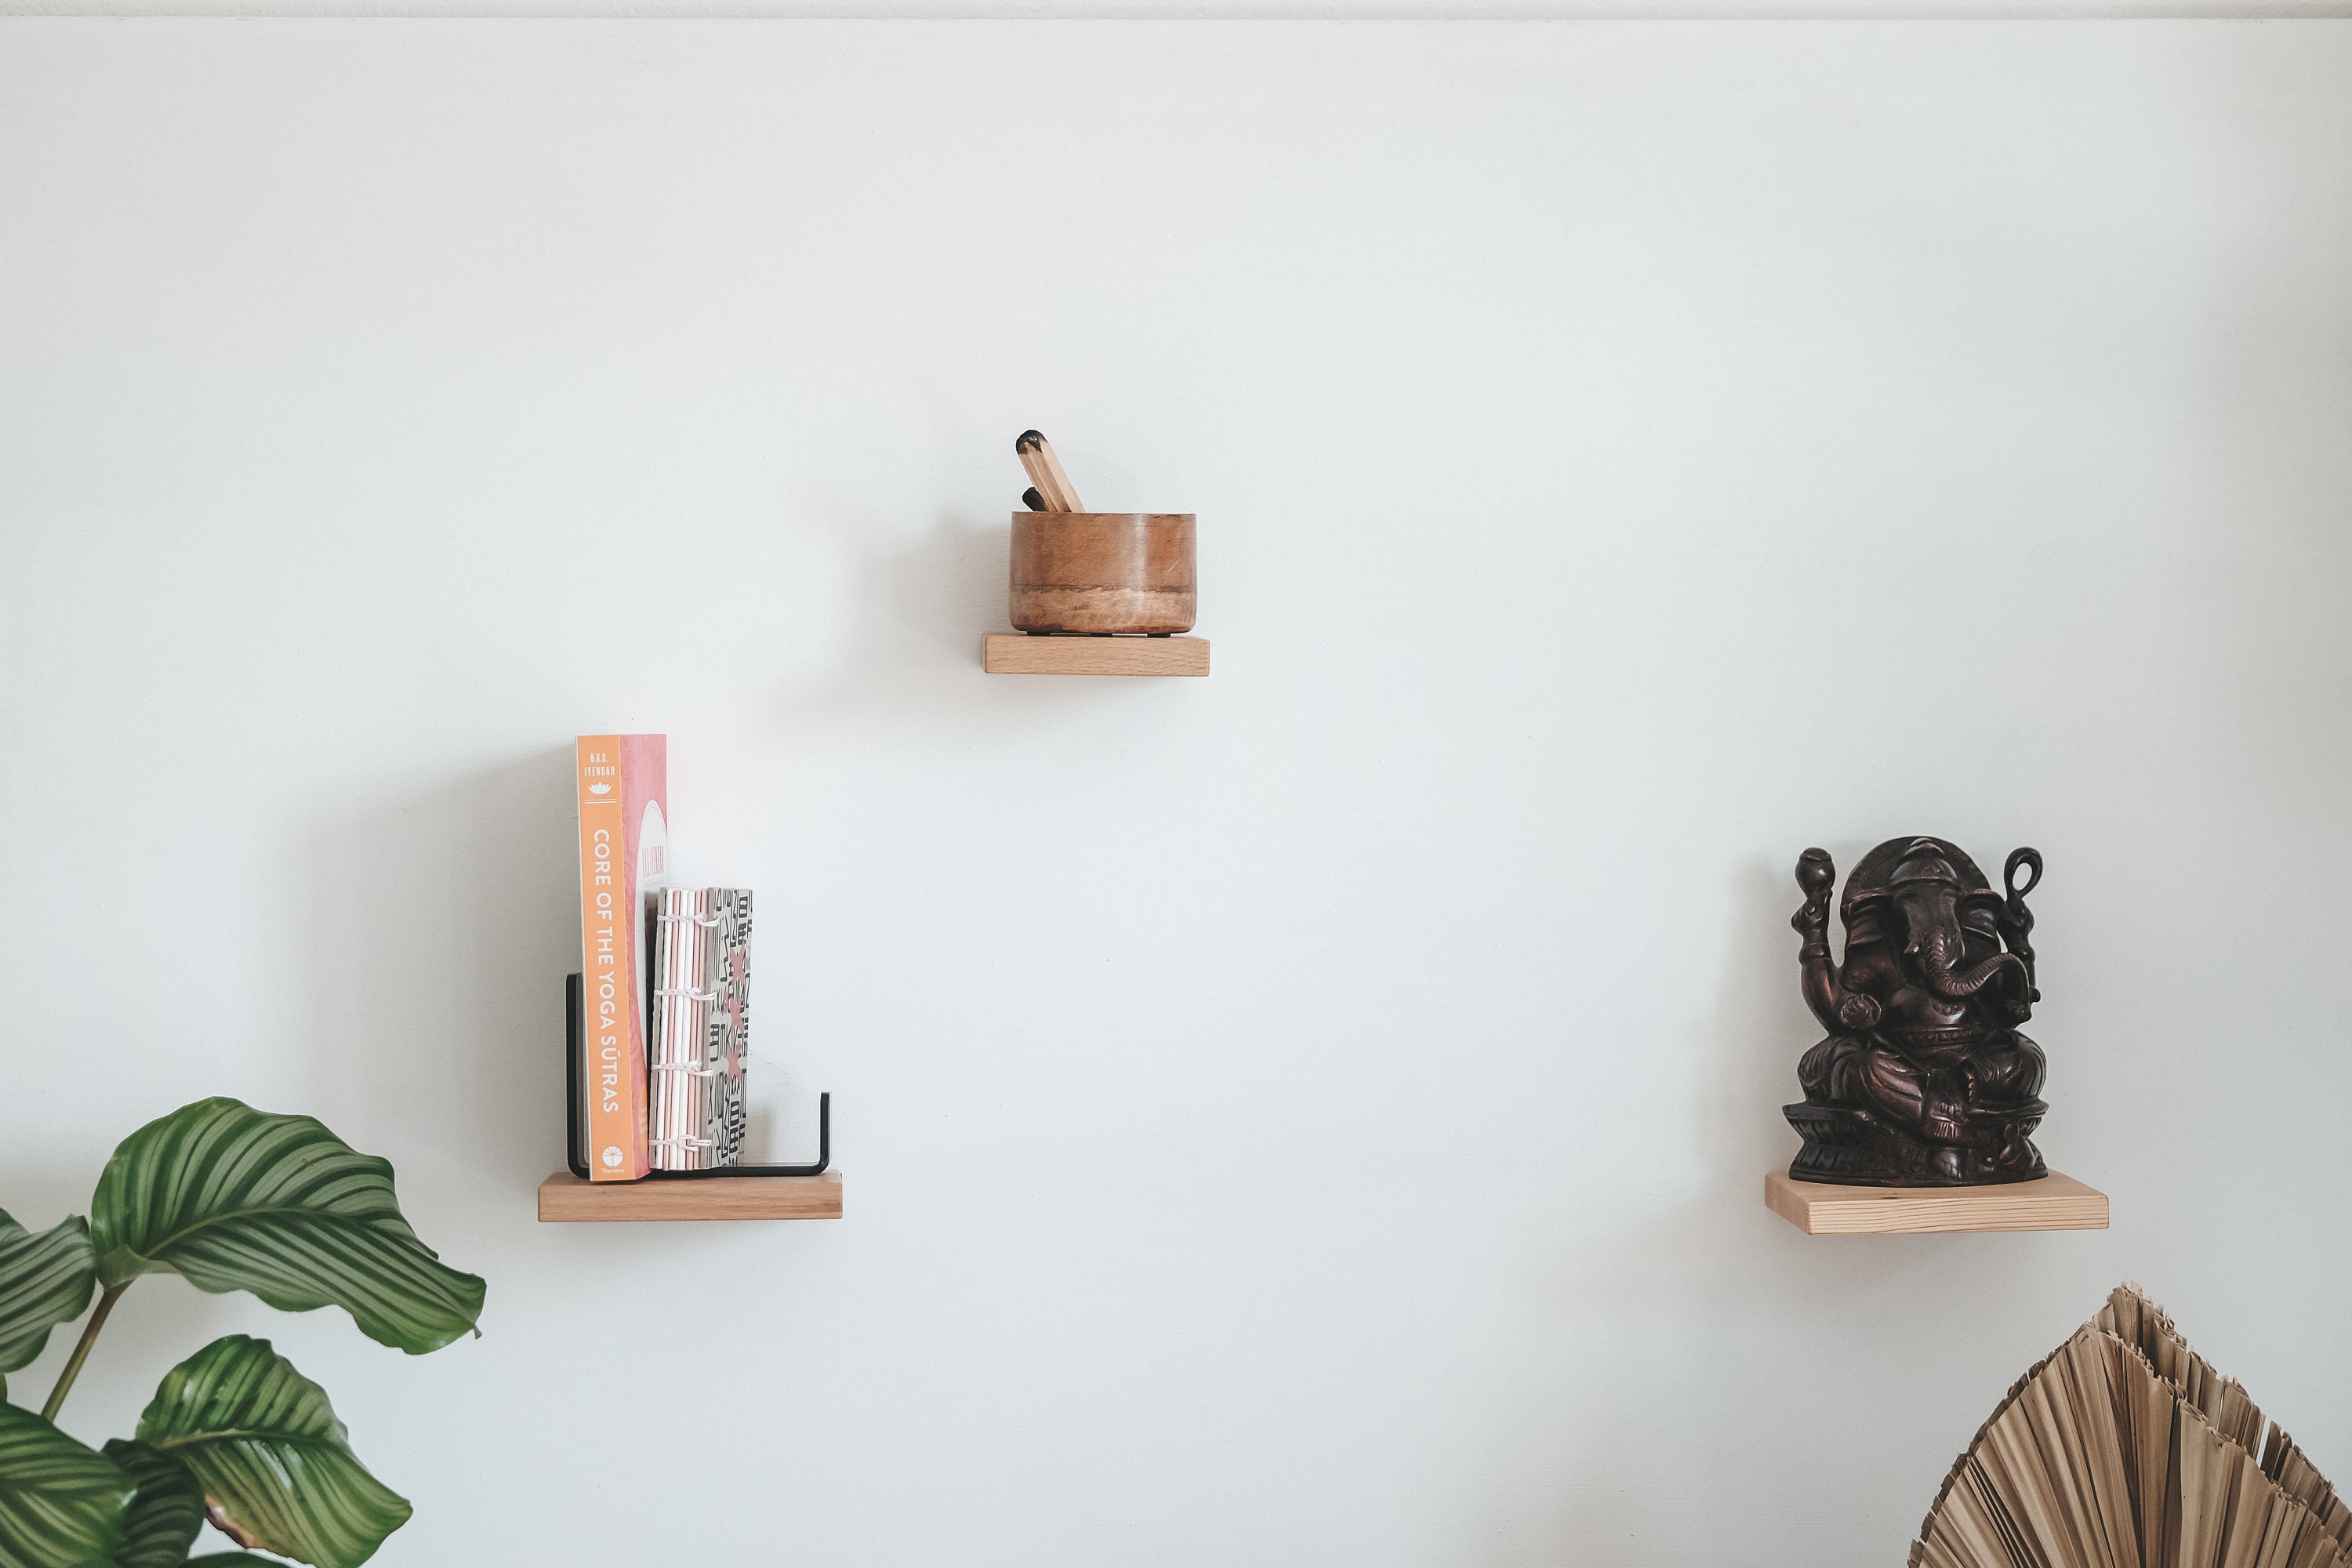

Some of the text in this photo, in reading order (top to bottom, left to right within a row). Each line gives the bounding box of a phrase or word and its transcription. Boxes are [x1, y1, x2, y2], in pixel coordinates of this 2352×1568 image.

[590, 753, 608, 763] B.K.S.
[593, 829, 620, 1112] CORE OF THE YOGA SŪTRAS
